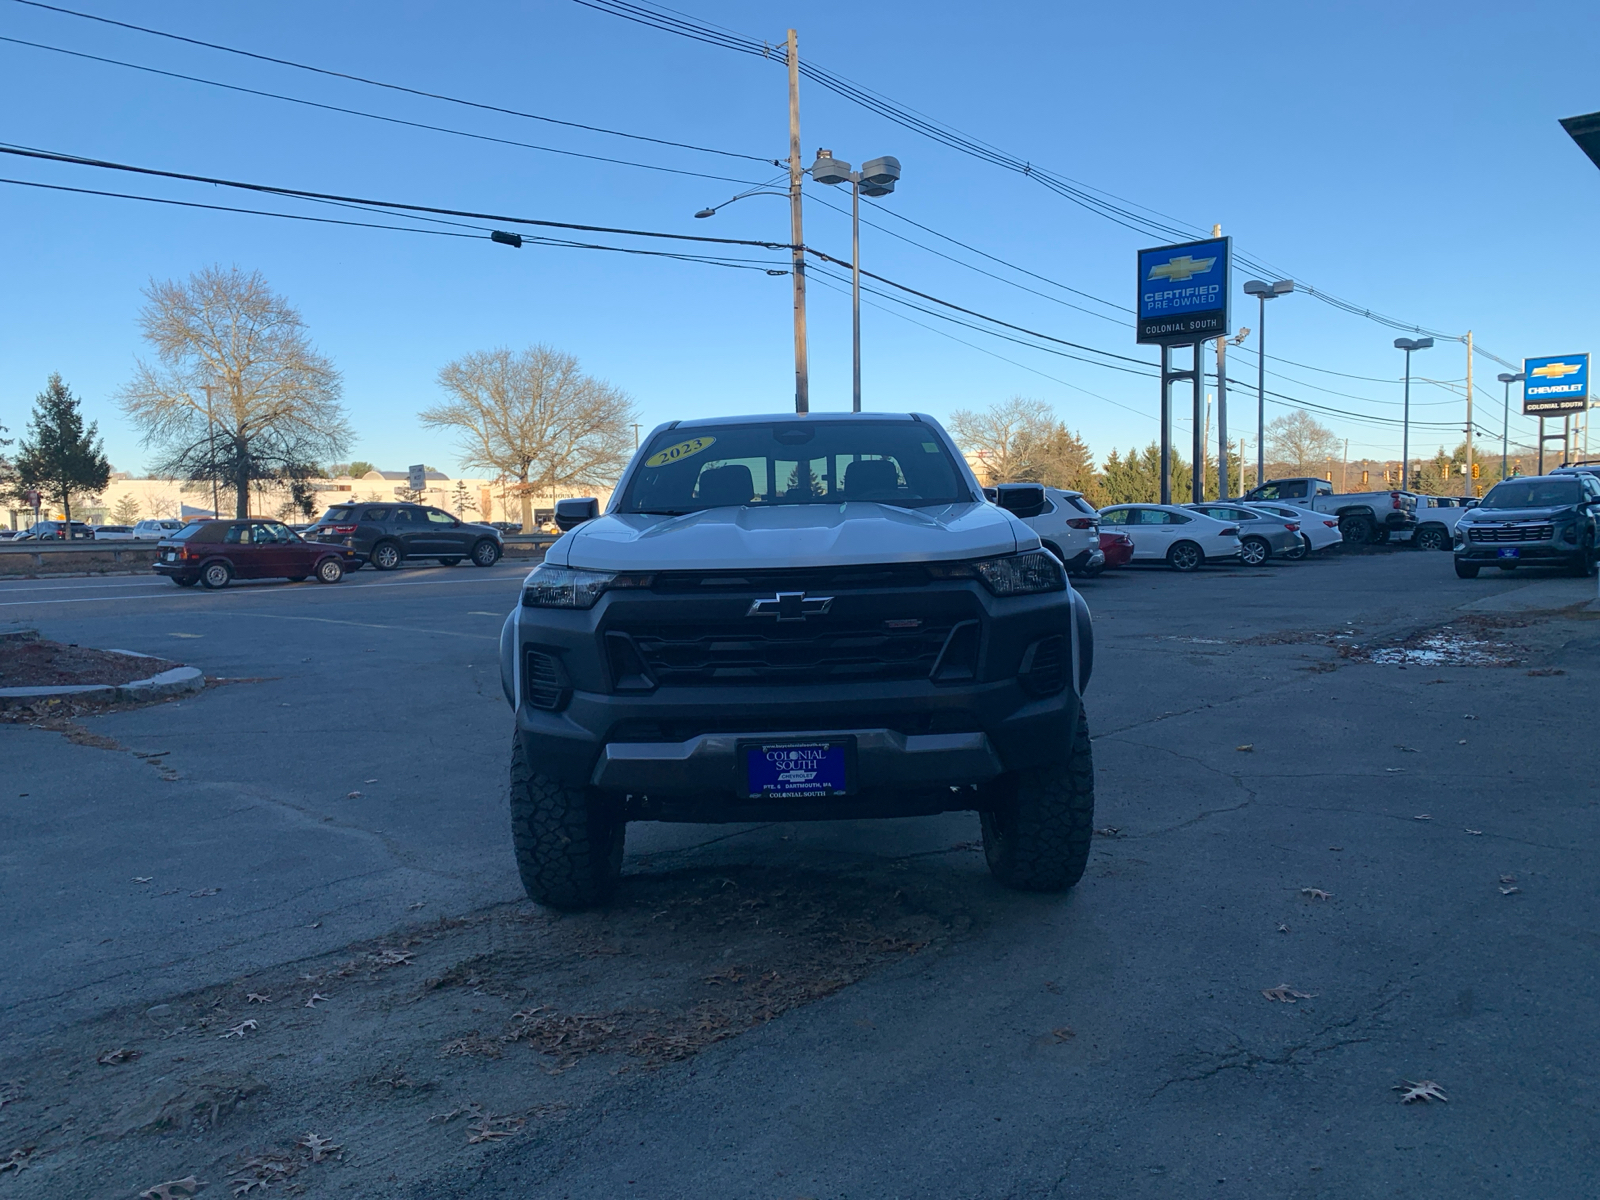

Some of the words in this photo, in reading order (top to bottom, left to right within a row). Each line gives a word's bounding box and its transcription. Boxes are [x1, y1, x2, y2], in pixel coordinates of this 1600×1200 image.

[1144, 284, 1219, 302] CERTIFIED
[1147, 294, 1215, 310] PRE-OWNED
[1146, 322, 1185, 334] COLONIAL
[1189, 319, 1217, 330] SOUTH
[1527, 384, 1583, 395] CHEVROLET
[658, 439, 703, 464] 2023
[766, 750, 826, 761] COLONIAL
[776, 760, 817, 770] SOUTH
